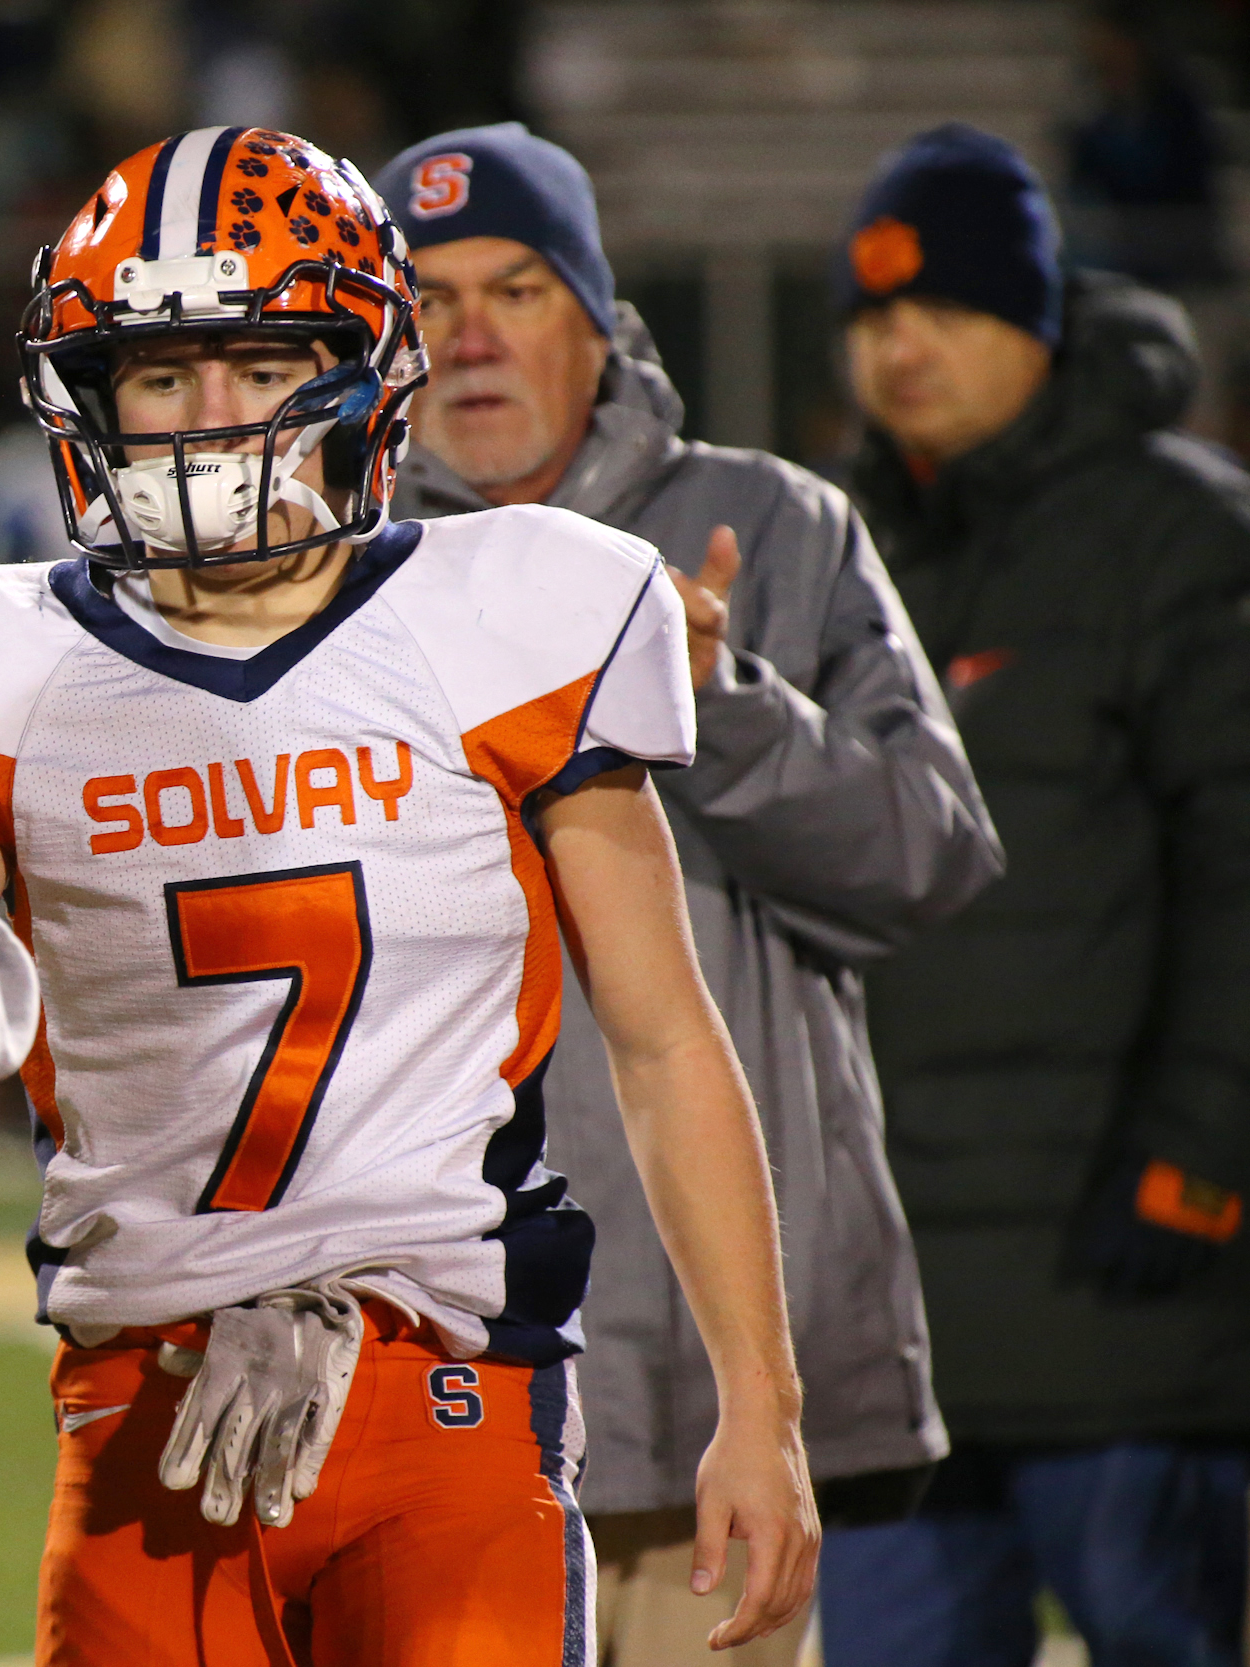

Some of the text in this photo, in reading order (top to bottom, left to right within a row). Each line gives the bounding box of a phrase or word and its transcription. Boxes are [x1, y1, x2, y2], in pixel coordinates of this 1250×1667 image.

[410, 153, 473, 219] S
[167, 461, 222, 477] shutt
[83, 741, 414, 855] SOLVAY
[164, 860, 374, 1214] 7
[427, 1363, 484, 1428] S
